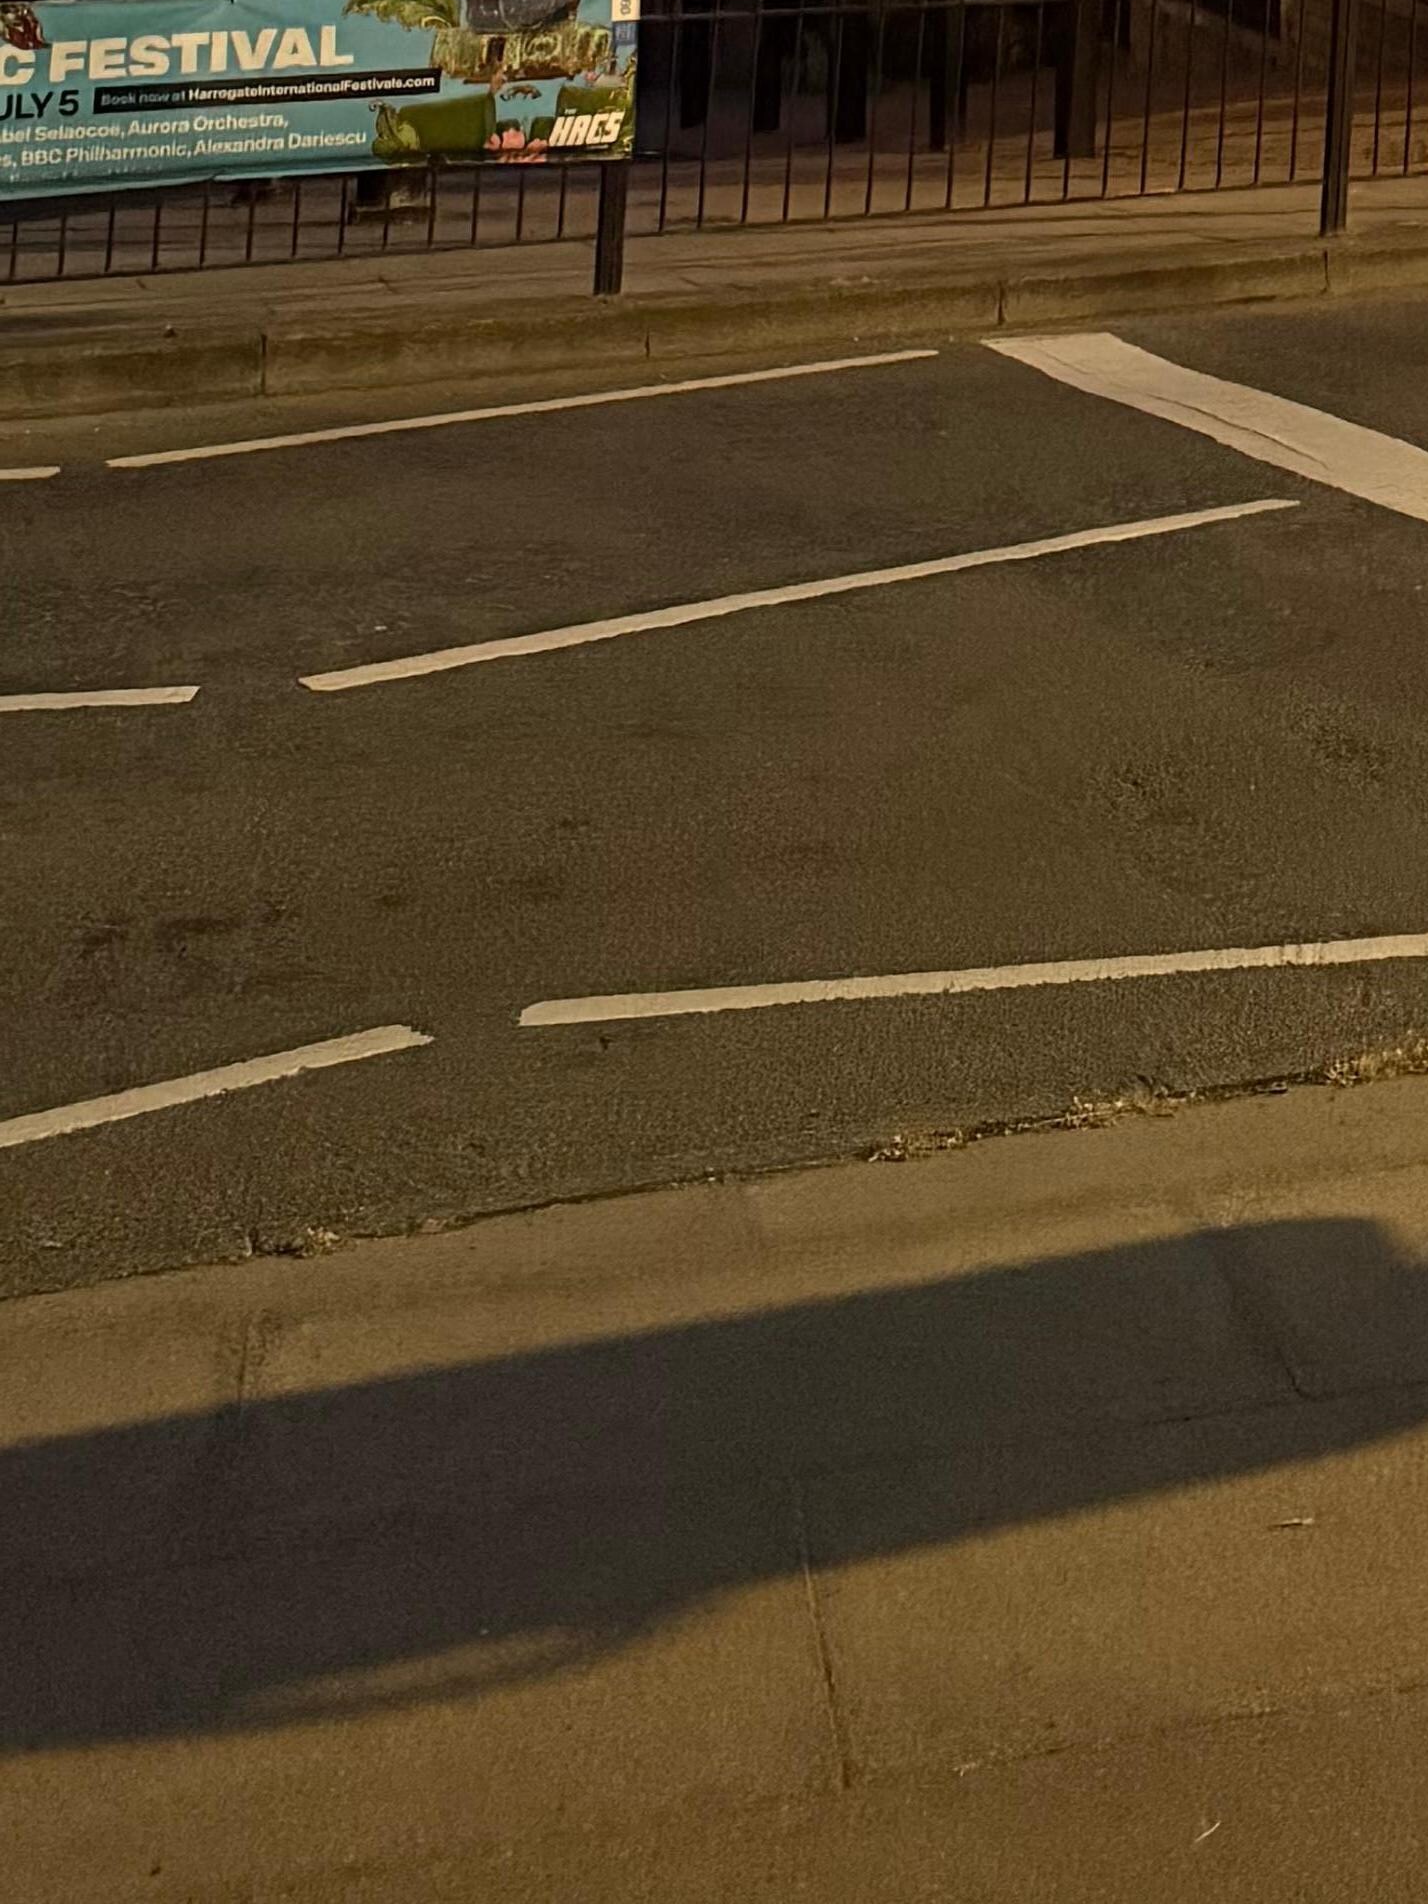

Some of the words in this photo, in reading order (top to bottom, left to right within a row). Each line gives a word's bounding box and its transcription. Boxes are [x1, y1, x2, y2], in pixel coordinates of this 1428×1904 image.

[48, 23, 355, 83] FESTIVAL
[58, 89, 79, 117] 5
[188, 76, 435, 102] HarrogateInternationalFestivals.com
[128, 120, 190, 136] Aurora
[192, 112, 290, 132] Orchestra,
[21, 148, 63, 167] BBC
[65, 140, 192, 164] Philharmonic,
[193, 136, 286, 156] Alexandra
[287, 130, 367, 149] Dariescu
